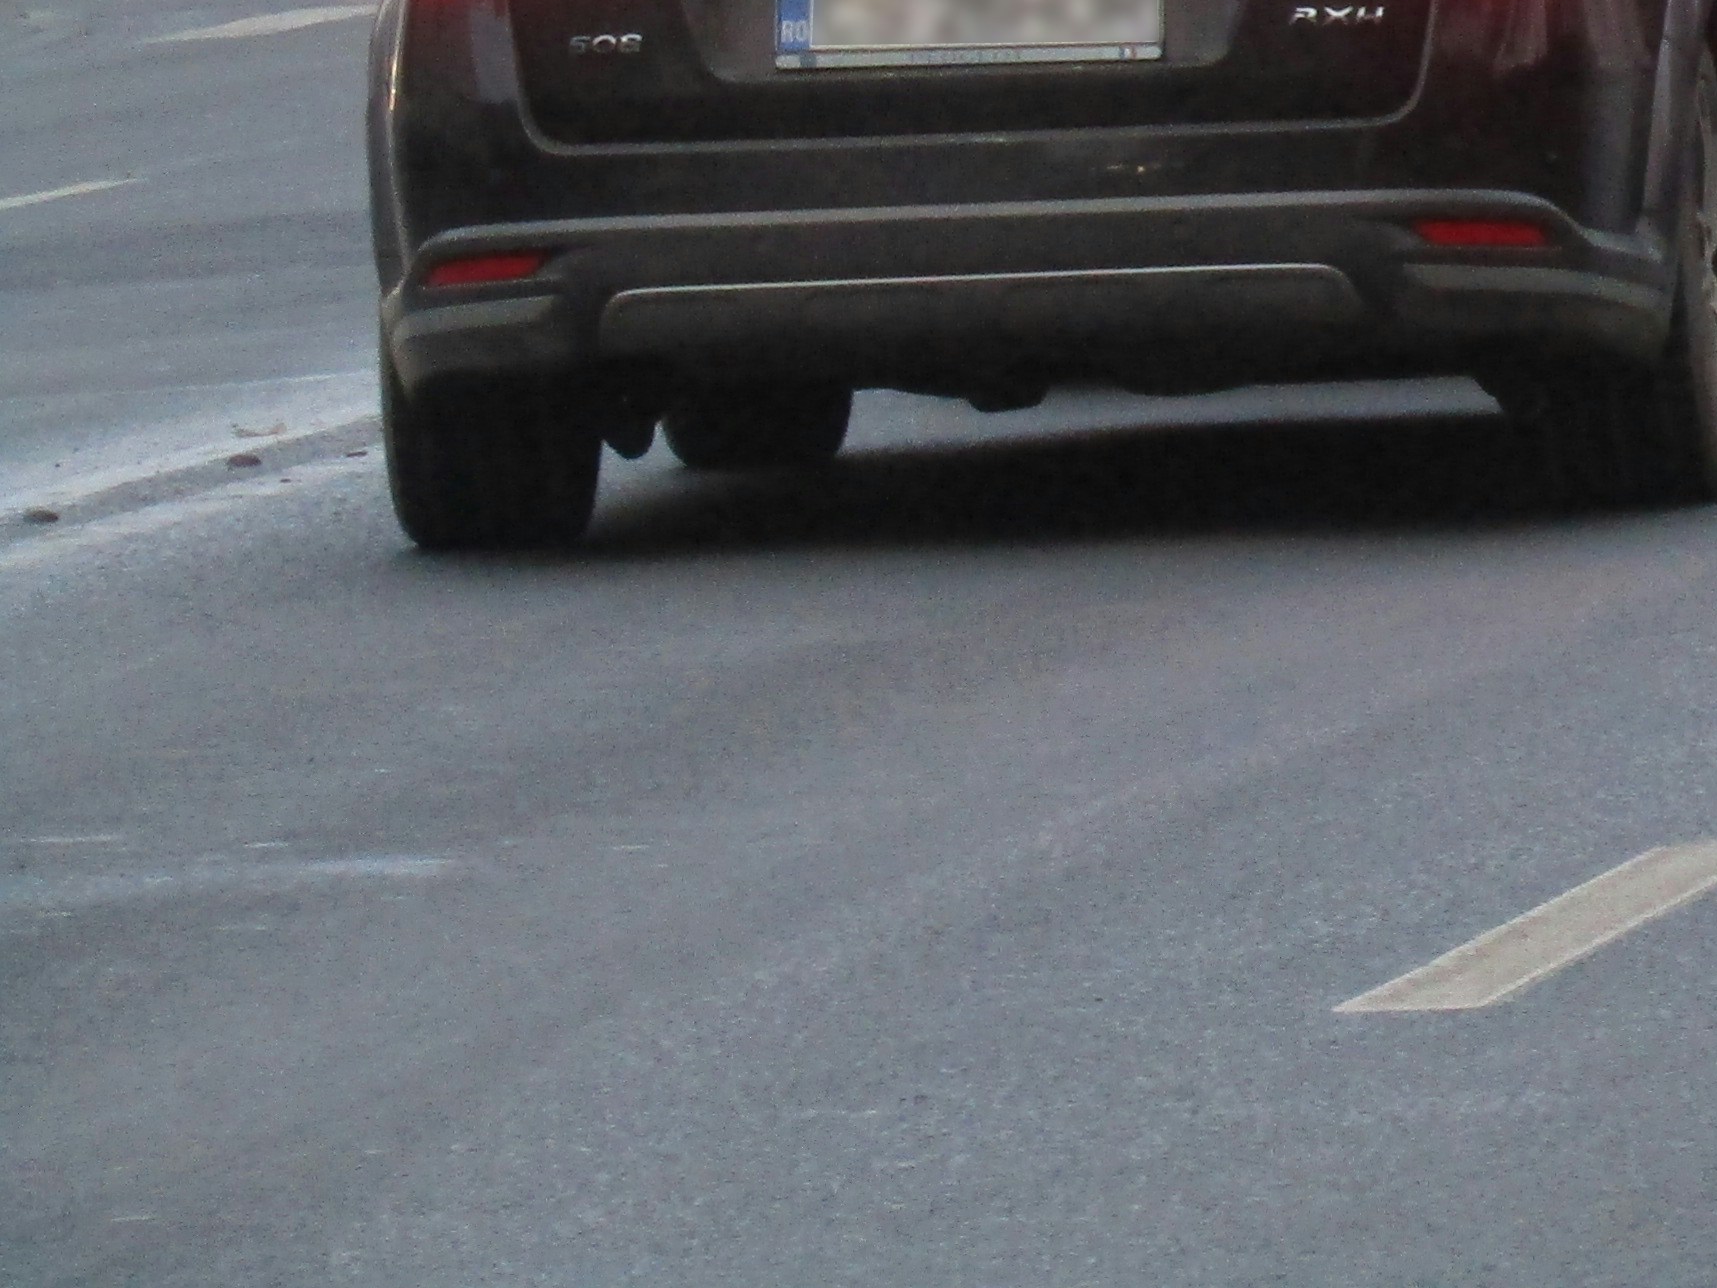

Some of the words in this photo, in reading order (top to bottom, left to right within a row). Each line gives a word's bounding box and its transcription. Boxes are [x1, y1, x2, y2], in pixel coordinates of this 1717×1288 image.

[1288, 6, 1386, 26] RXH
[779, 19, 812, 44] RO
[568, 33, 643, 54] 508
